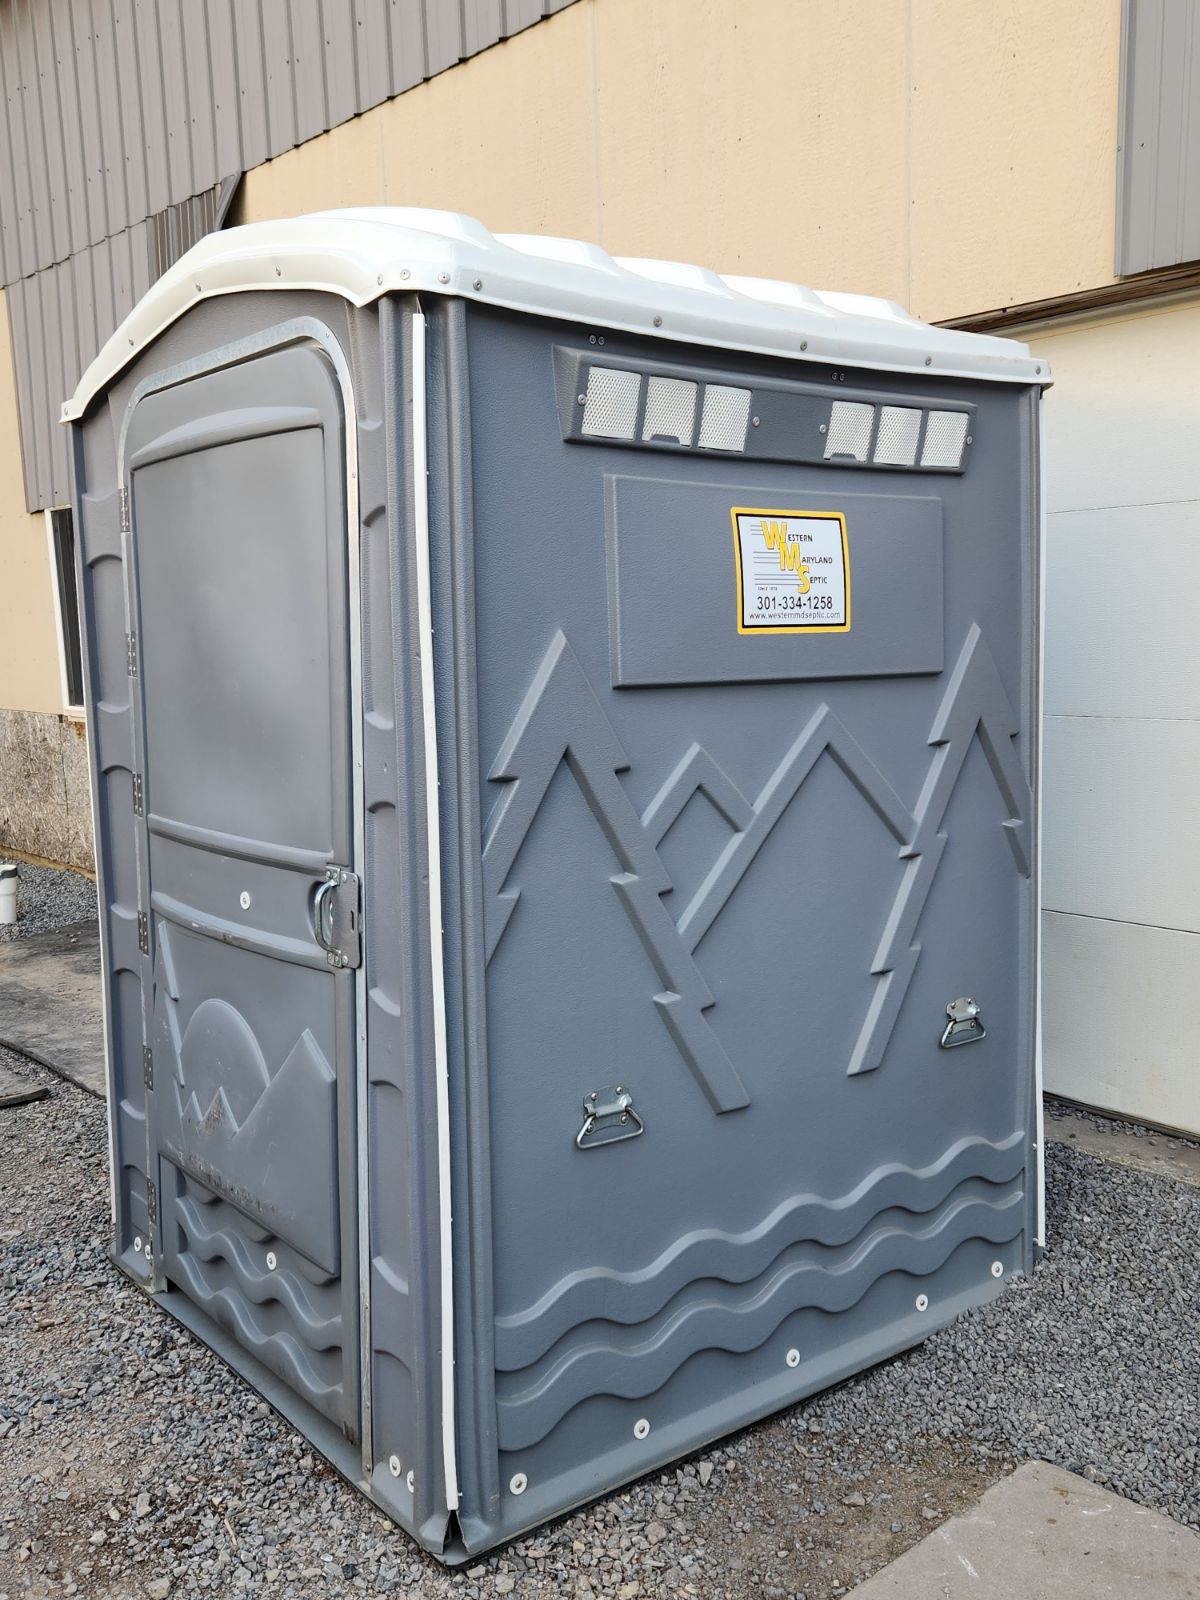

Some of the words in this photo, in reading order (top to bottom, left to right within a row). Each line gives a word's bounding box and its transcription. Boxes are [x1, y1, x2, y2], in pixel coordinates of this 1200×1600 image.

[760, 521, 813, 550] WESTERN
[779, 542, 833, 571] MARYLAND
[797, 565, 828, 594] SEPTIC
[749, 611, 841, 620] www.westernmdseptic.com
[757, 596, 833, 610] 301-334-1258
